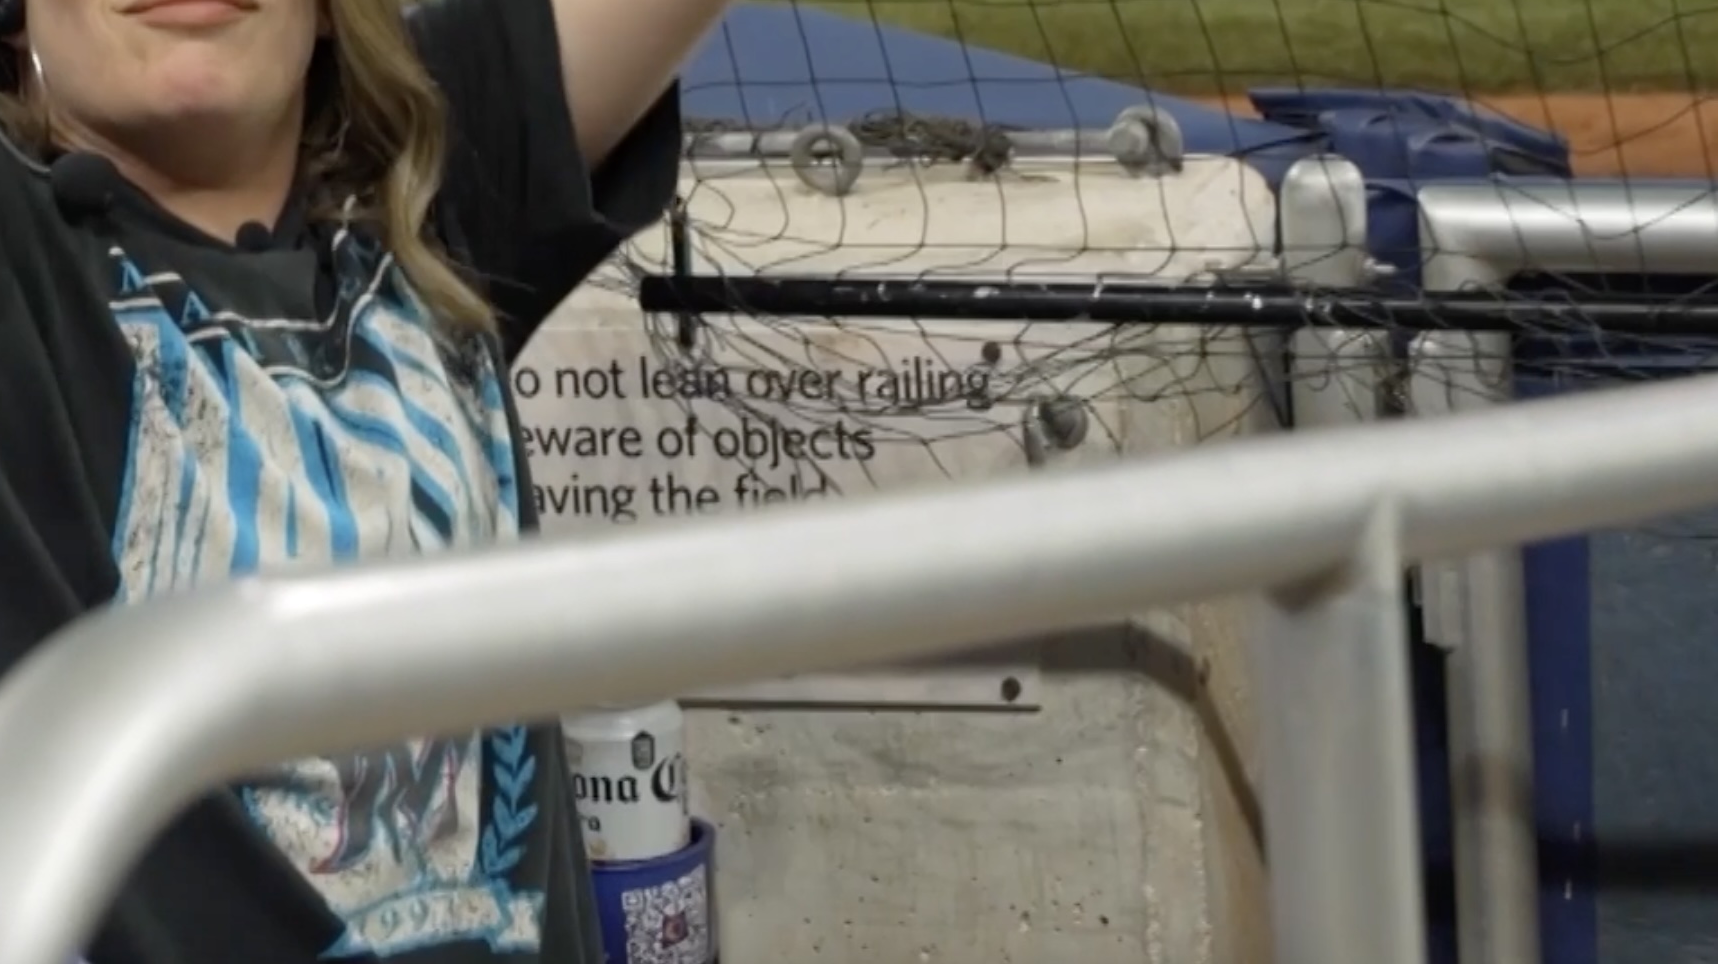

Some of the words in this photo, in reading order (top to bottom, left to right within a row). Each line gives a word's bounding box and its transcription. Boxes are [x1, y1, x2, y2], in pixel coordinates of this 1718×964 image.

[515, 367, 541, 398] o
[555, 359, 626, 399] not
[640, 355, 731, 400] lean
[746, 367, 842, 400] over
[857, 356, 991, 411] railing
[521, 425, 643, 457] eware
[657, 415, 697, 457] of
[713, 415, 876, 469] objects
[532, 472, 636, 522] aving
[649, 472, 720, 516] the
[573, 773, 640, 804] ona
